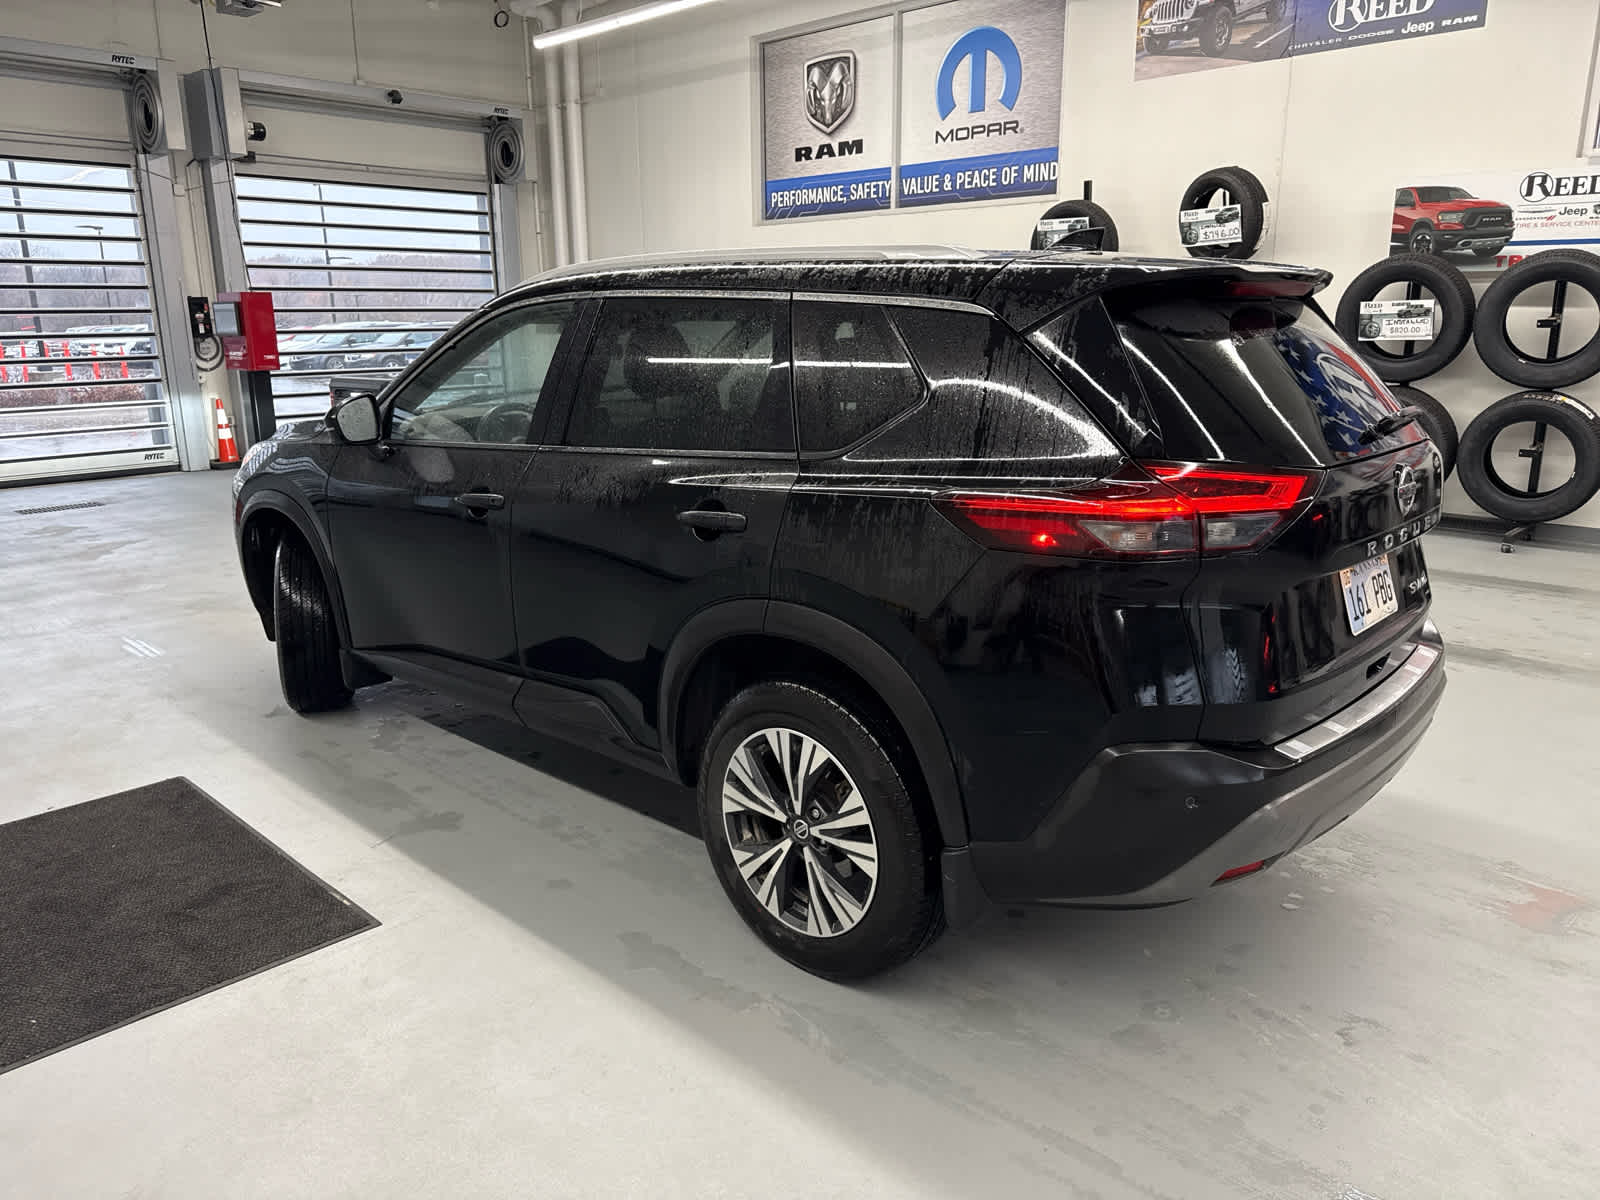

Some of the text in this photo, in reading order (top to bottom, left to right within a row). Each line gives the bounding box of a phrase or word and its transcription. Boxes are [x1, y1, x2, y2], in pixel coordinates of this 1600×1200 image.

[1329, 0, 1436, 32] REED
[1287, 15, 1479, 50] CHRYSLER DODGE Jeep RAM
[111, 54, 136, 65] RYTEC
[935, 119, 1020, 144] MOPAR
[795, 139, 864, 162] RAM
[771, 160, 1058, 208] PERFORMANCE, SAFETY VALUE & PEACE OF MIND
[1559, 207, 1588, 216] Jeep
[144, 452, 165, 461] RYTEC
[1367, 515, 1432, 557] ROGUE
[1348, 581, 1372, 622] 161
[1371, 569, 1393, 609] PBG
